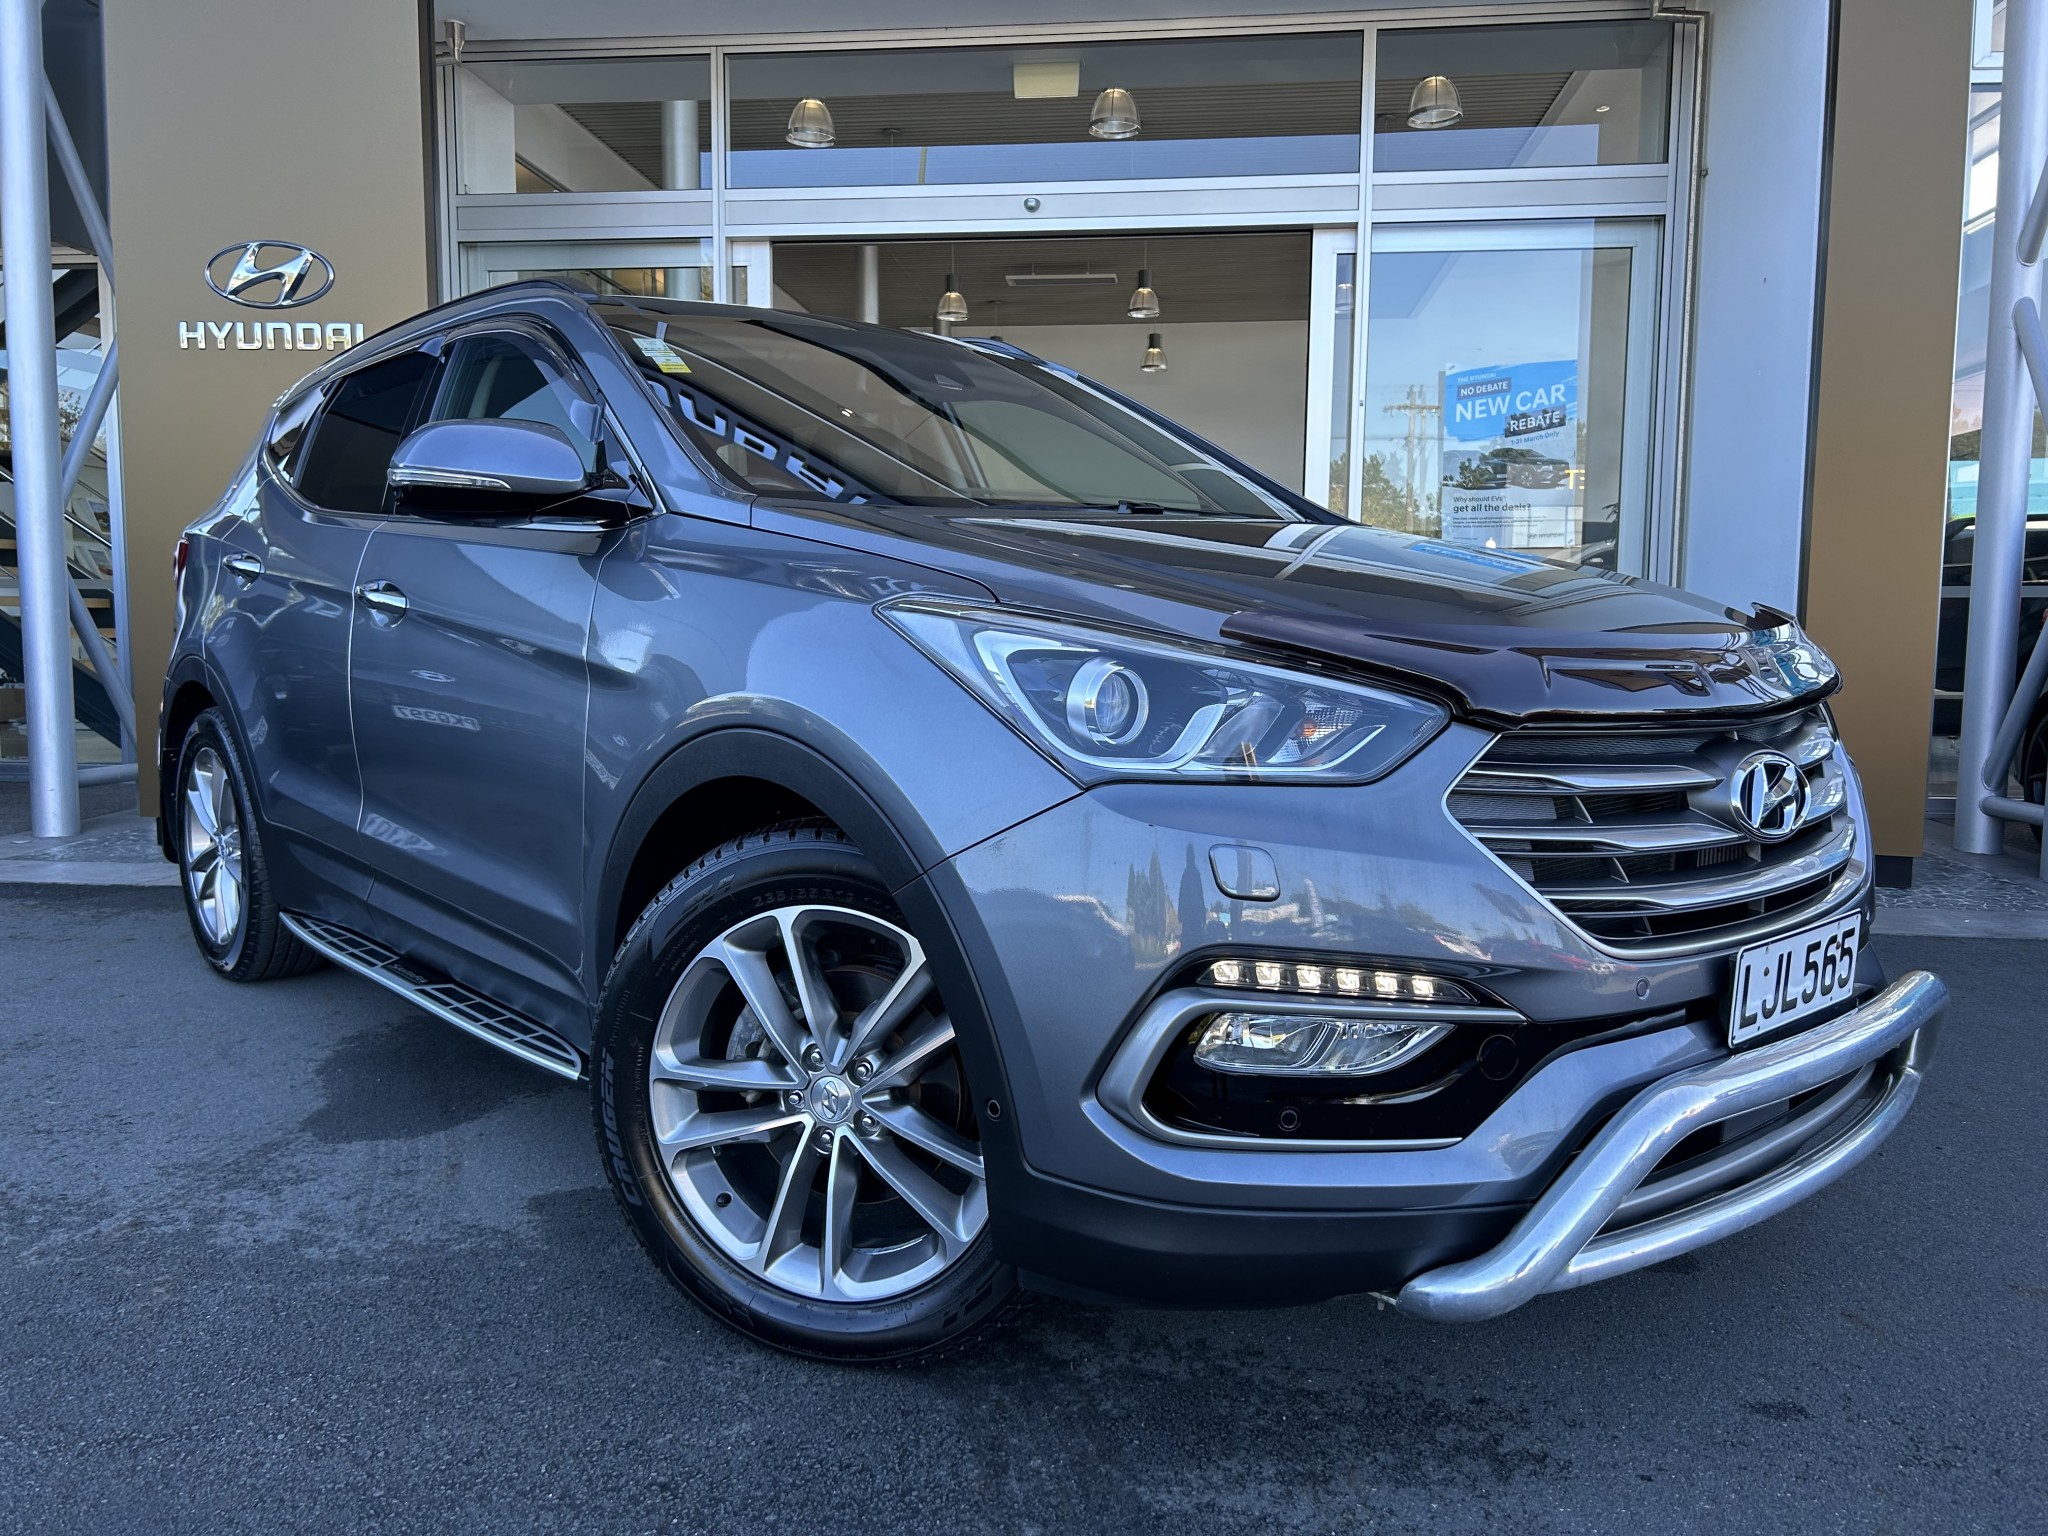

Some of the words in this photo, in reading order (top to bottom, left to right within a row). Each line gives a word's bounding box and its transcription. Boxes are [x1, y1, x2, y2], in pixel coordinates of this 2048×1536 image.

[178, 321, 365, 351] HYUNDAI
[1469, 373, 1496, 381] HYUNDAI
[1460, 387, 1474, 397] NO
[1476, 381, 1508, 394] DEBATE
[1455, 394, 1511, 423] NEW
[1515, 383, 1567, 412] CAR
[1509, 411, 1561, 432] REBATE
[1523, 434, 1544, 444] March
[1544, 430, 1560, 439] Only
[1453, 505, 1469, 513] get
[1470, 503, 1482, 512] all
[1484, 503, 1500, 511] the
[1501, 503, 1531, 512] deals?
[1739, 927, 1856, 1029] LJL565
[601, 1047, 643, 1206] CRUGEN
